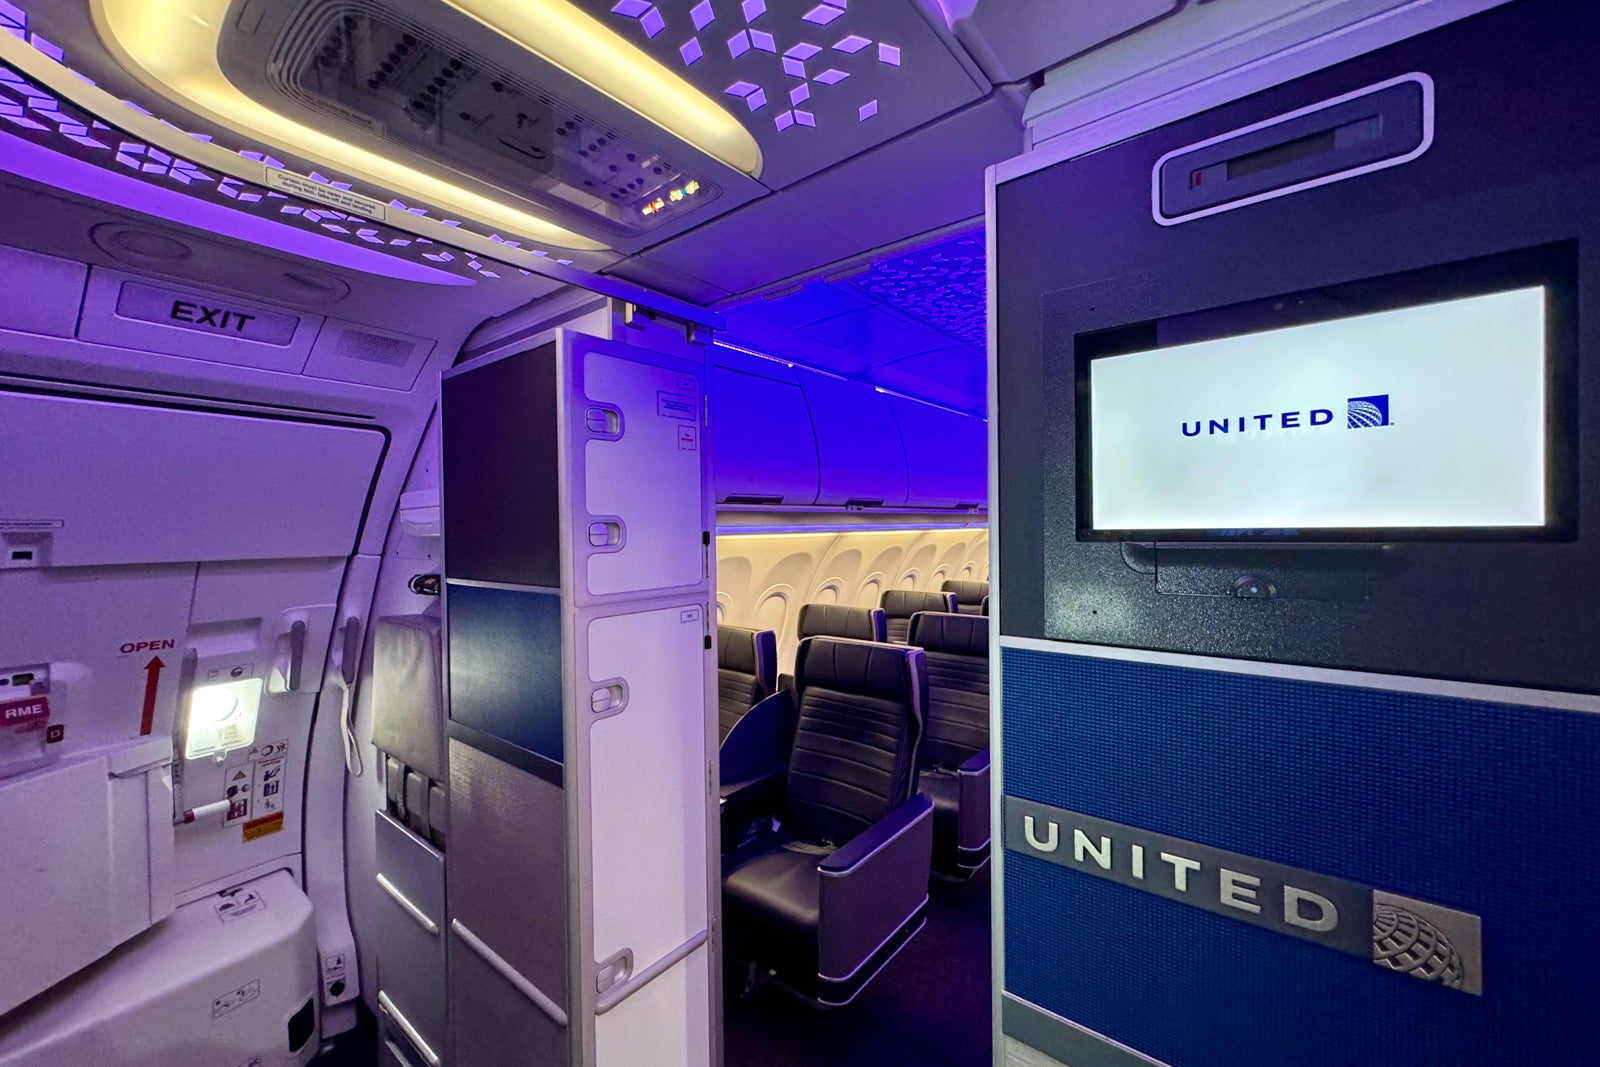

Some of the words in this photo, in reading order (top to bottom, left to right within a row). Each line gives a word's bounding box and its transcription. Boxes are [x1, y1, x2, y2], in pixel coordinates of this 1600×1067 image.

[278, 174, 301, 186] Curtain
[318, 185, 326, 193] be
[342, 194, 353, 203] and
[282, 181, 303, 192] during
[340, 197, 351, 206] and
[351, 202, 373, 214] landing
[170, 300, 256, 332] EXIT
[1182, 408, 1333, 437] UNITED
[120, 638, 175, 653] OPEN
[50, 730, 61, 739] D
[1024, 815, 1338, 932] UNITED
